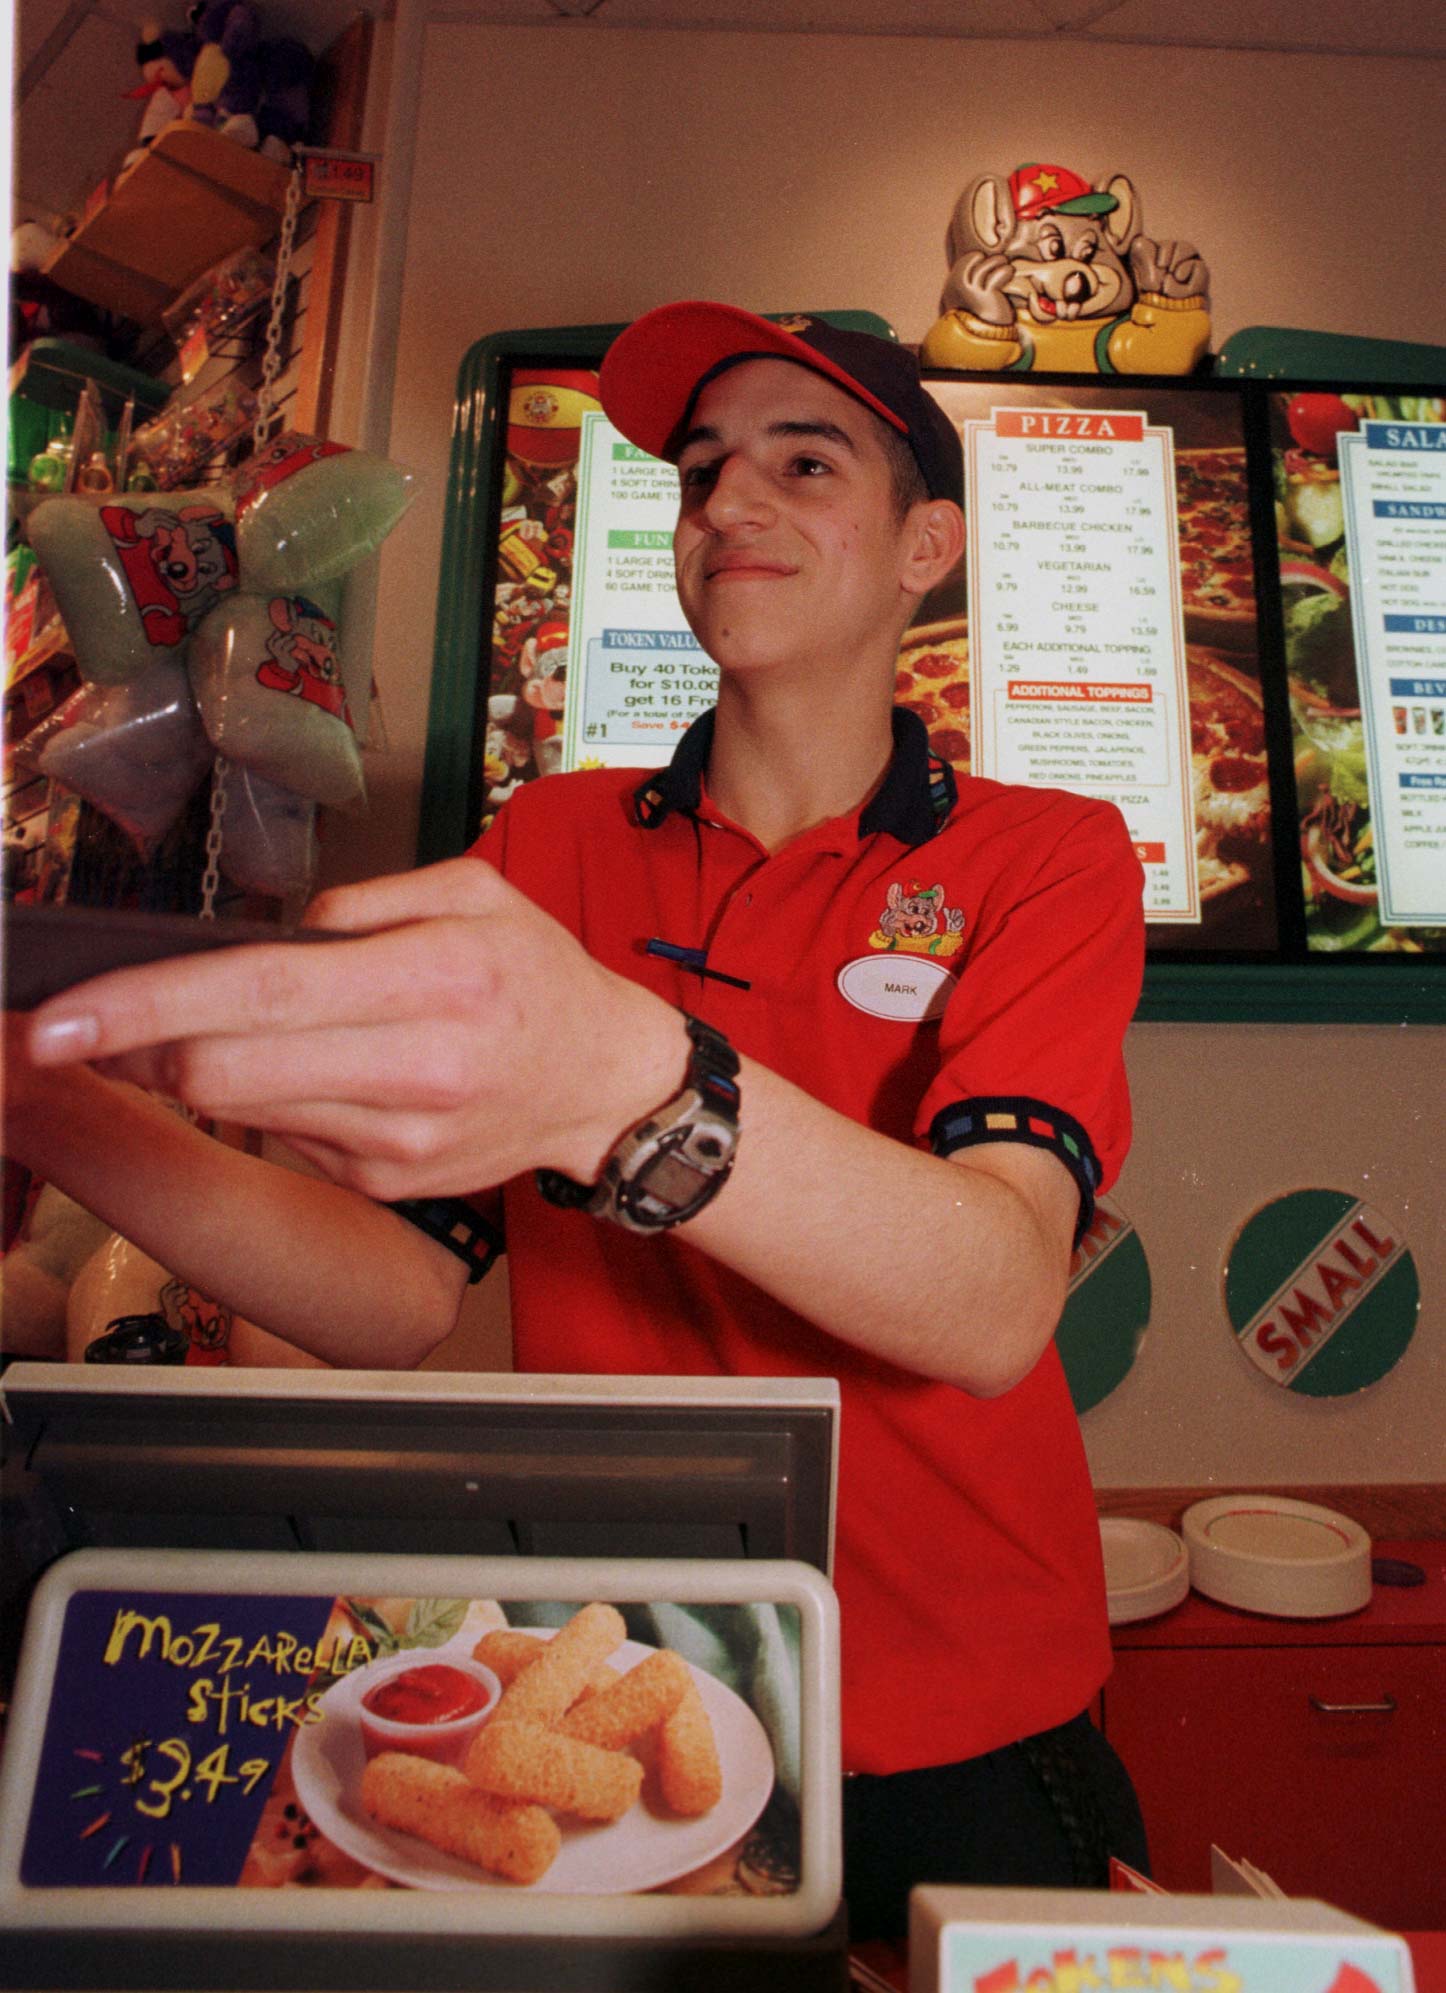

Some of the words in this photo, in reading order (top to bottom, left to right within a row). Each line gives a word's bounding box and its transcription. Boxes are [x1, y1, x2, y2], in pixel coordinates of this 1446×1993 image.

[1021, 415, 1115, 437] PIZZA
[1026, 444, 1065, 454] SUPER
[1070, 444, 1113, 456] COMBO
[620, 468, 656, 476] LARGE
[991, 463, 1017, 472] 10.79
[1057, 465, 1083, 475] 13.99
[1019, 482, 1075, 492] ALL-MEAT
[1080, 483, 1123, 494] COMBO
[611, 491, 628, 499] 100
[631, 492, 661, 500] GAME
[992, 502, 1018, 512] 10.79
[1059, 504, 1085, 514] 13.99
[1012, 521, 1075, 531] BARBECUE
[1081, 522, 1133, 533] CHICKEN
[634, 534, 669, 546] FUN
[993, 541, 1020, 551] 10.79
[1060, 543, 1086, 553] 13.99
[615, 557, 653, 565] LARGE
[656, 557, 675, 565] PIZ
[1037, 560, 1112, 572] VEGETARIAN
[620, 583, 651, 591] GAME
[1051, 602, 1099, 612] CHEESE
[608, 632, 655, 648] TOKEN
[659, 633, 700, 649] VALU
[1003, 641, 1034, 652] EACH
[1036, 642, 1101, 654] ADDITIONAL
[610, 662, 647, 675] Buy
[653, 664, 676, 674] 40
[629, 679, 655, 689] for
[661, 679, 719, 690] $10.00
[1012, 685, 1085, 698] ADDITIONAL
[1088, 687, 1149, 699] TOPPINGS
[624, 695, 655, 707] get
[662, 695, 682, 706] 16
[607, 710, 629, 719] (For
[631, 720, 664, 729] Save
[1007, 716, 1051, 725] CANADIAN
[1054, 718, 1080, 726] STYLE
[586, 722, 608, 737] #1
[1032, 730, 1060, 739] BLACK
[1018, 744, 1047, 752] GREEN
[1029, 772, 1047, 780] RED
[1086, 773, 1137, 781] PINEAPPLES
[1120, 795, 1149, 804] PIZZA
[884, 983, 917, 995] MARK
[1256, 1220, 1396, 1370] SMALL
[120, 1737, 270, 1818] $3.49
